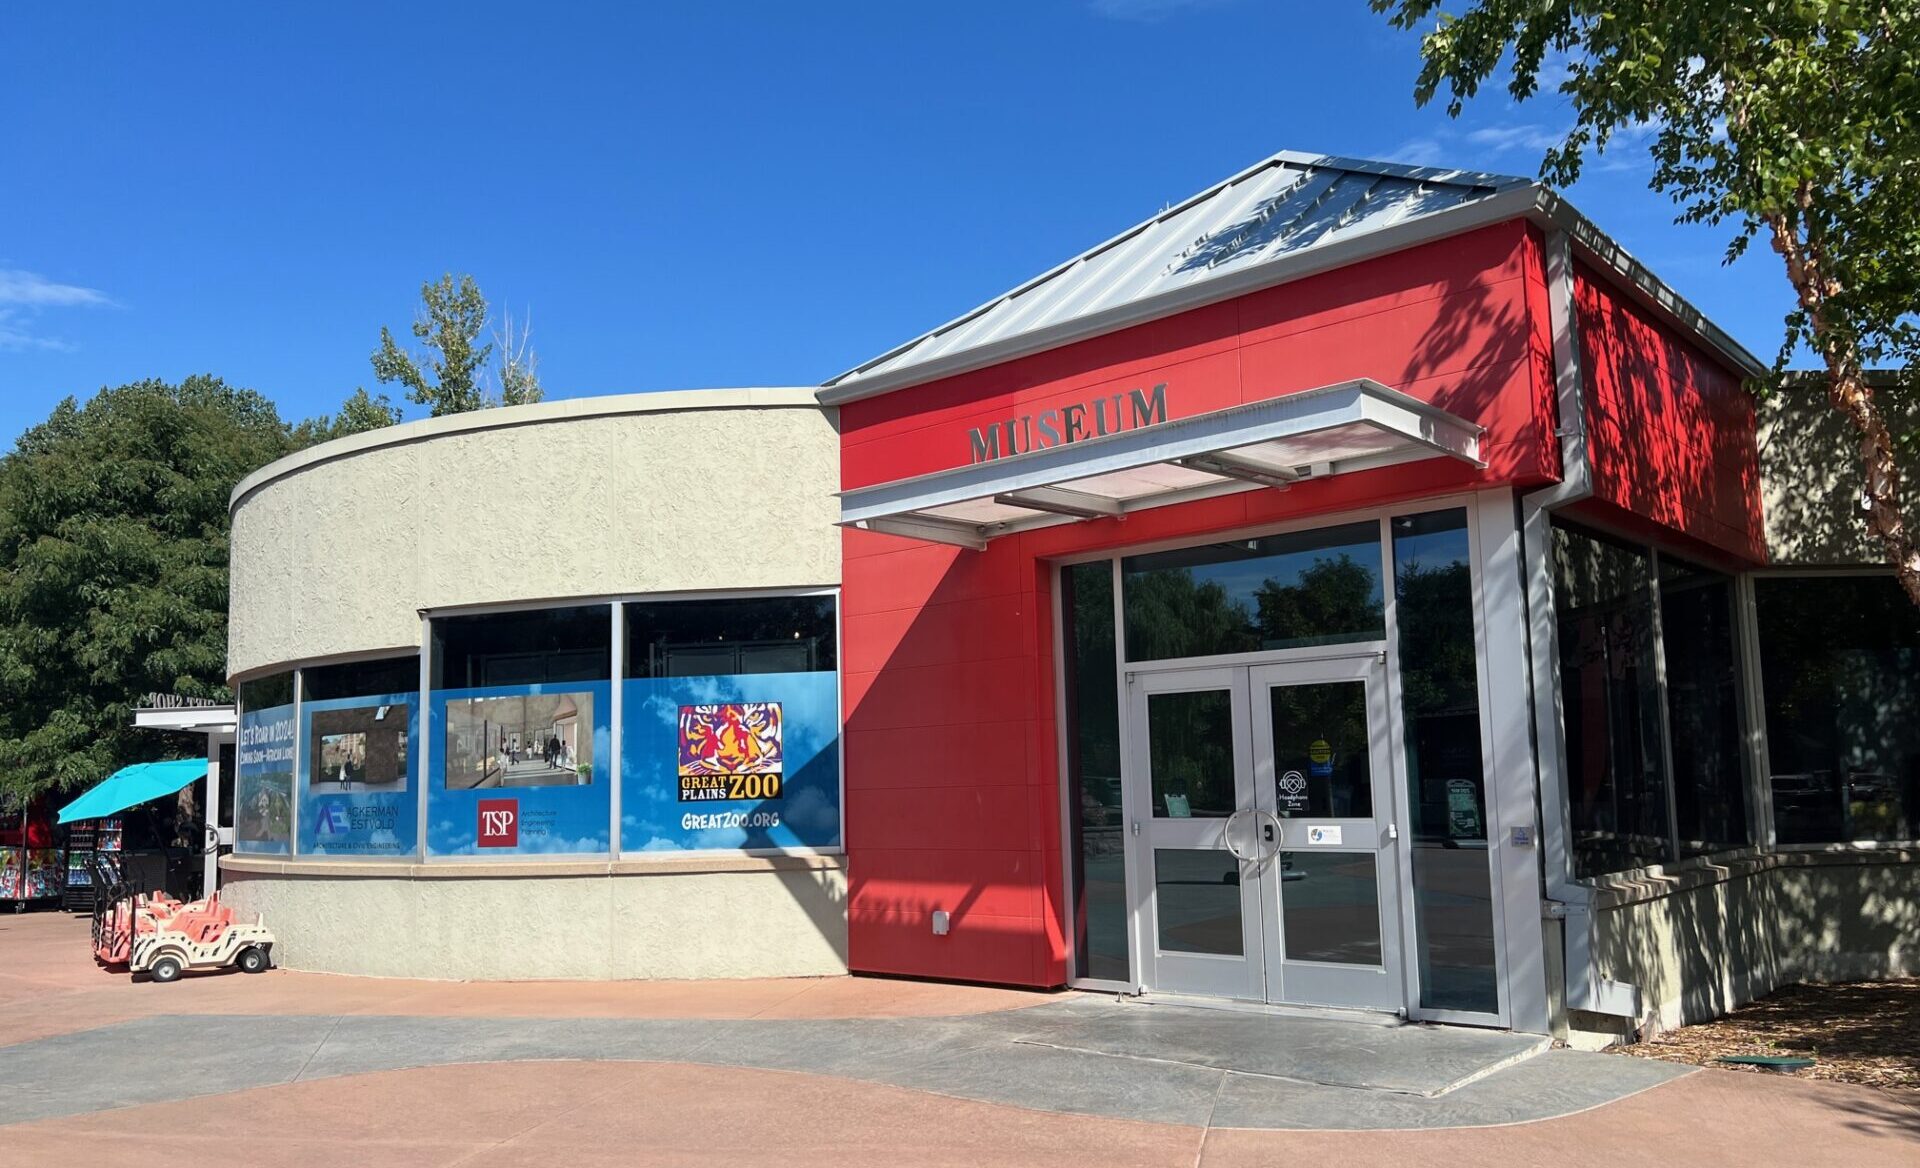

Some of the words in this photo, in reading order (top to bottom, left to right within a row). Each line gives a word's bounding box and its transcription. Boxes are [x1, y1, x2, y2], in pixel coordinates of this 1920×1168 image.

[967, 381, 1168, 464] MUSEUM
[681, 776, 727, 789] GREAT
[729, 774, 779, 799] ZOO
[682, 788, 727, 800] PLAINS
[346, 805, 399, 818] ACKERMAN
[351, 819, 395, 830] ESTVOLD
[482, 811, 514, 836] TSP
